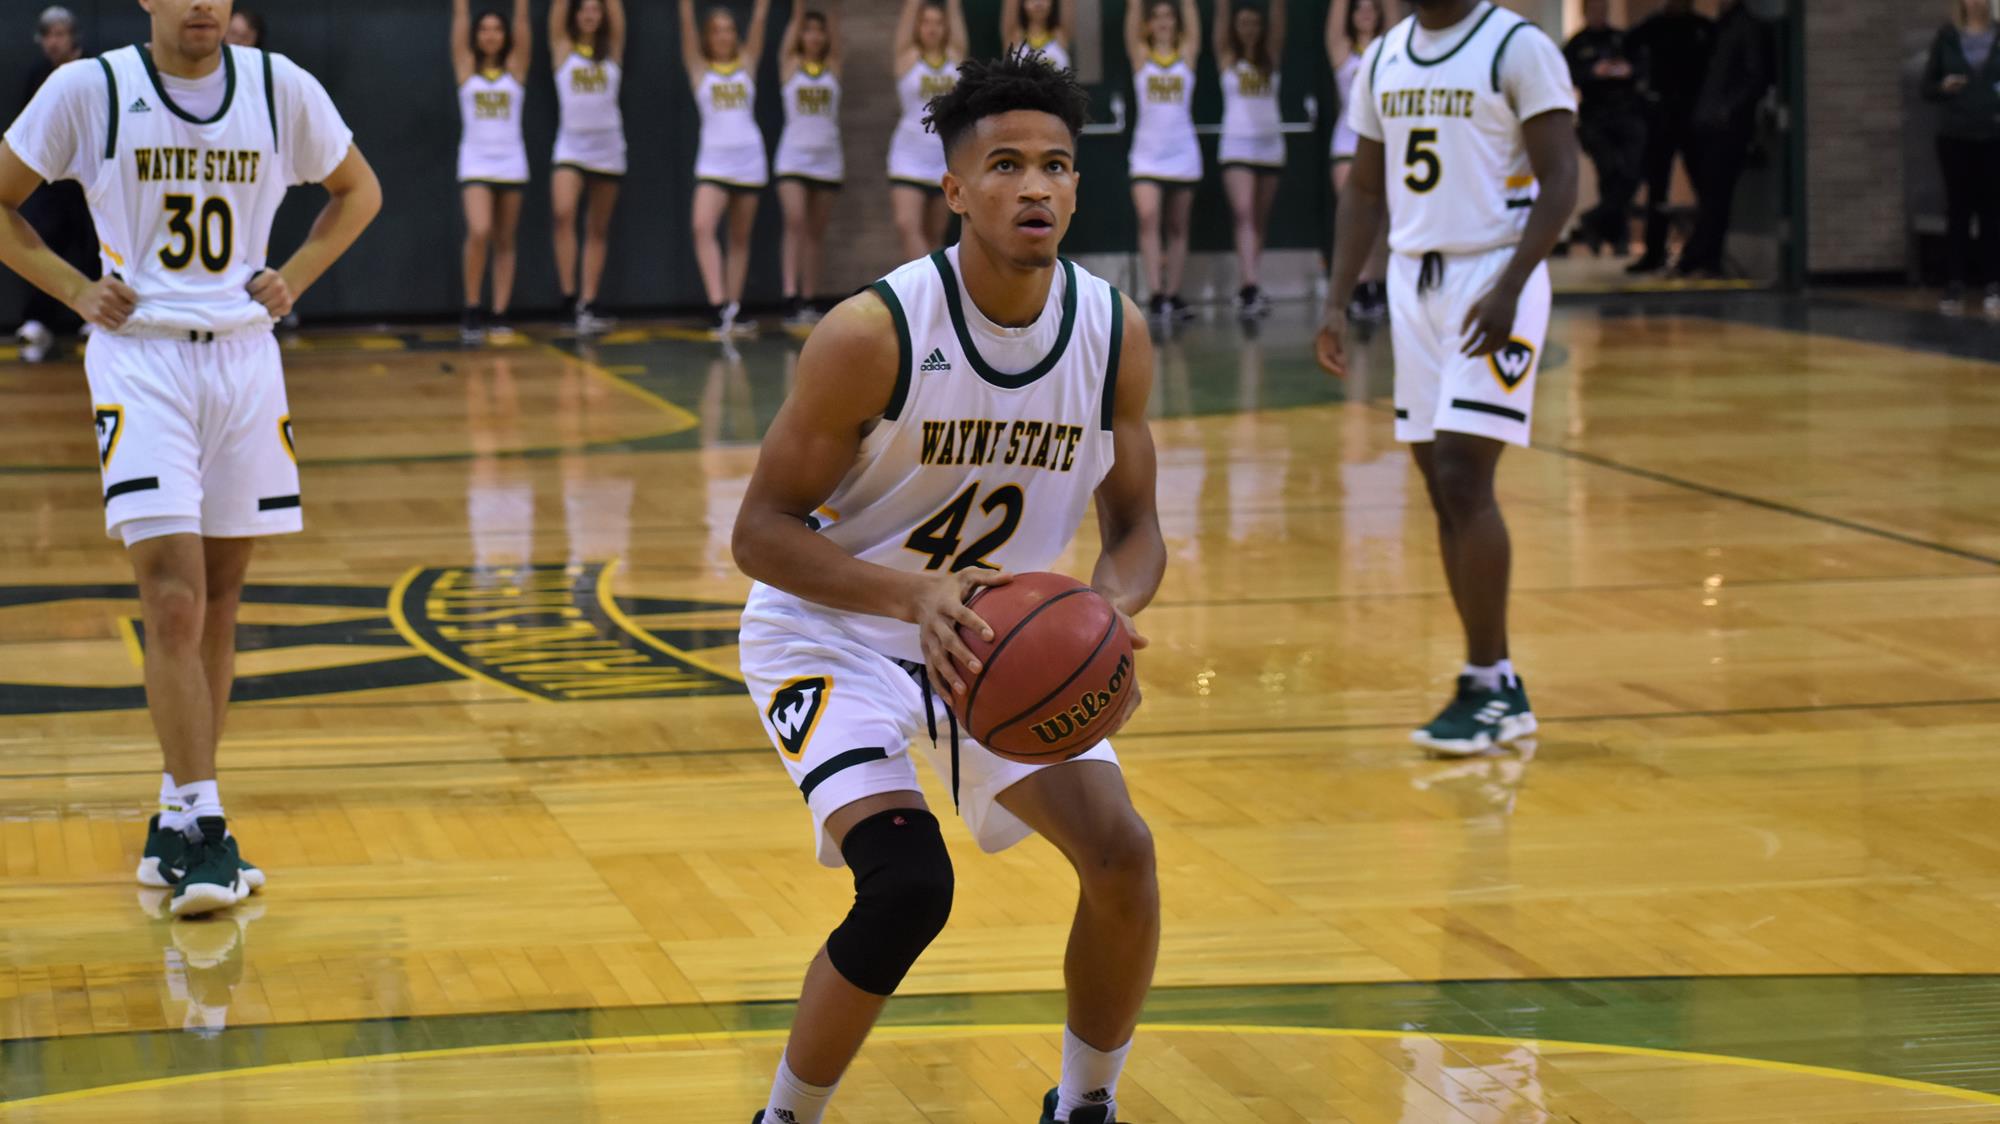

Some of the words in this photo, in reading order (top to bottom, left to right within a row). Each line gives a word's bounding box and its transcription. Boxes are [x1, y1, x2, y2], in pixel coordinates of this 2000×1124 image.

[1431, 88, 1475, 118] STATE
[134, 147, 198, 182] WAYNE
[204, 149, 260, 184] STATE
[1404, 127, 1442, 194] 5
[159, 192, 234, 275] 30
[920, 361, 951, 372] adidas
[1004, 420, 1083, 472] STATE
[903, 479, 1024, 574] 42
[1029, 653, 1130, 744] Wilson
